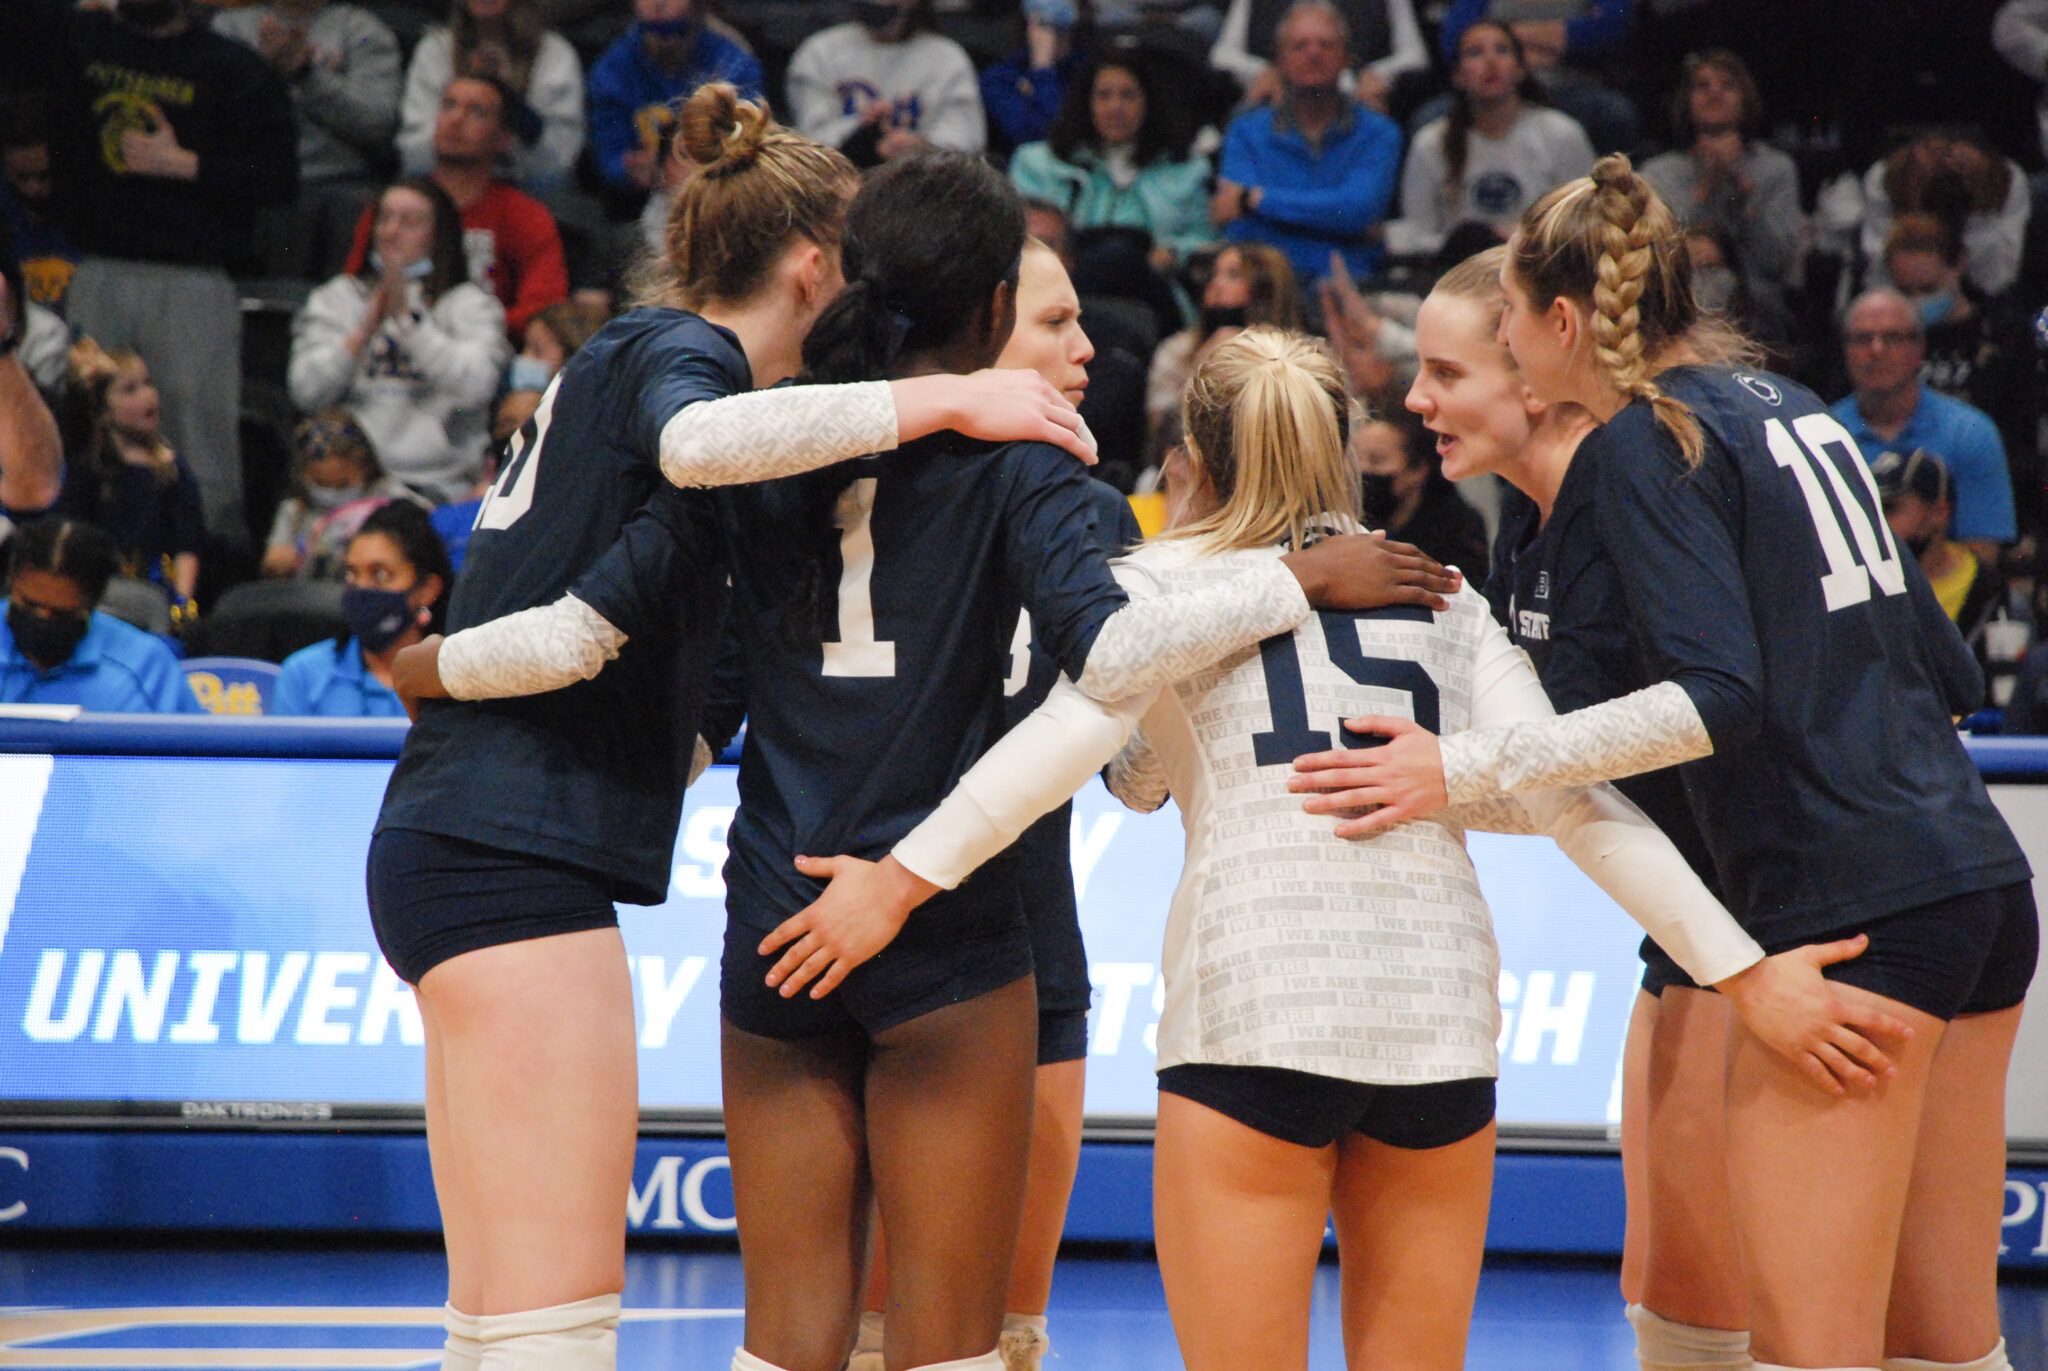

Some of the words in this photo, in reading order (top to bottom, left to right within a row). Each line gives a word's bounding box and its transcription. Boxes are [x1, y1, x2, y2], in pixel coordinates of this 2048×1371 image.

[819, 477, 896, 678] 1
[1763, 412, 1907, 613] 10
[1252, 600, 1441, 768] 15
